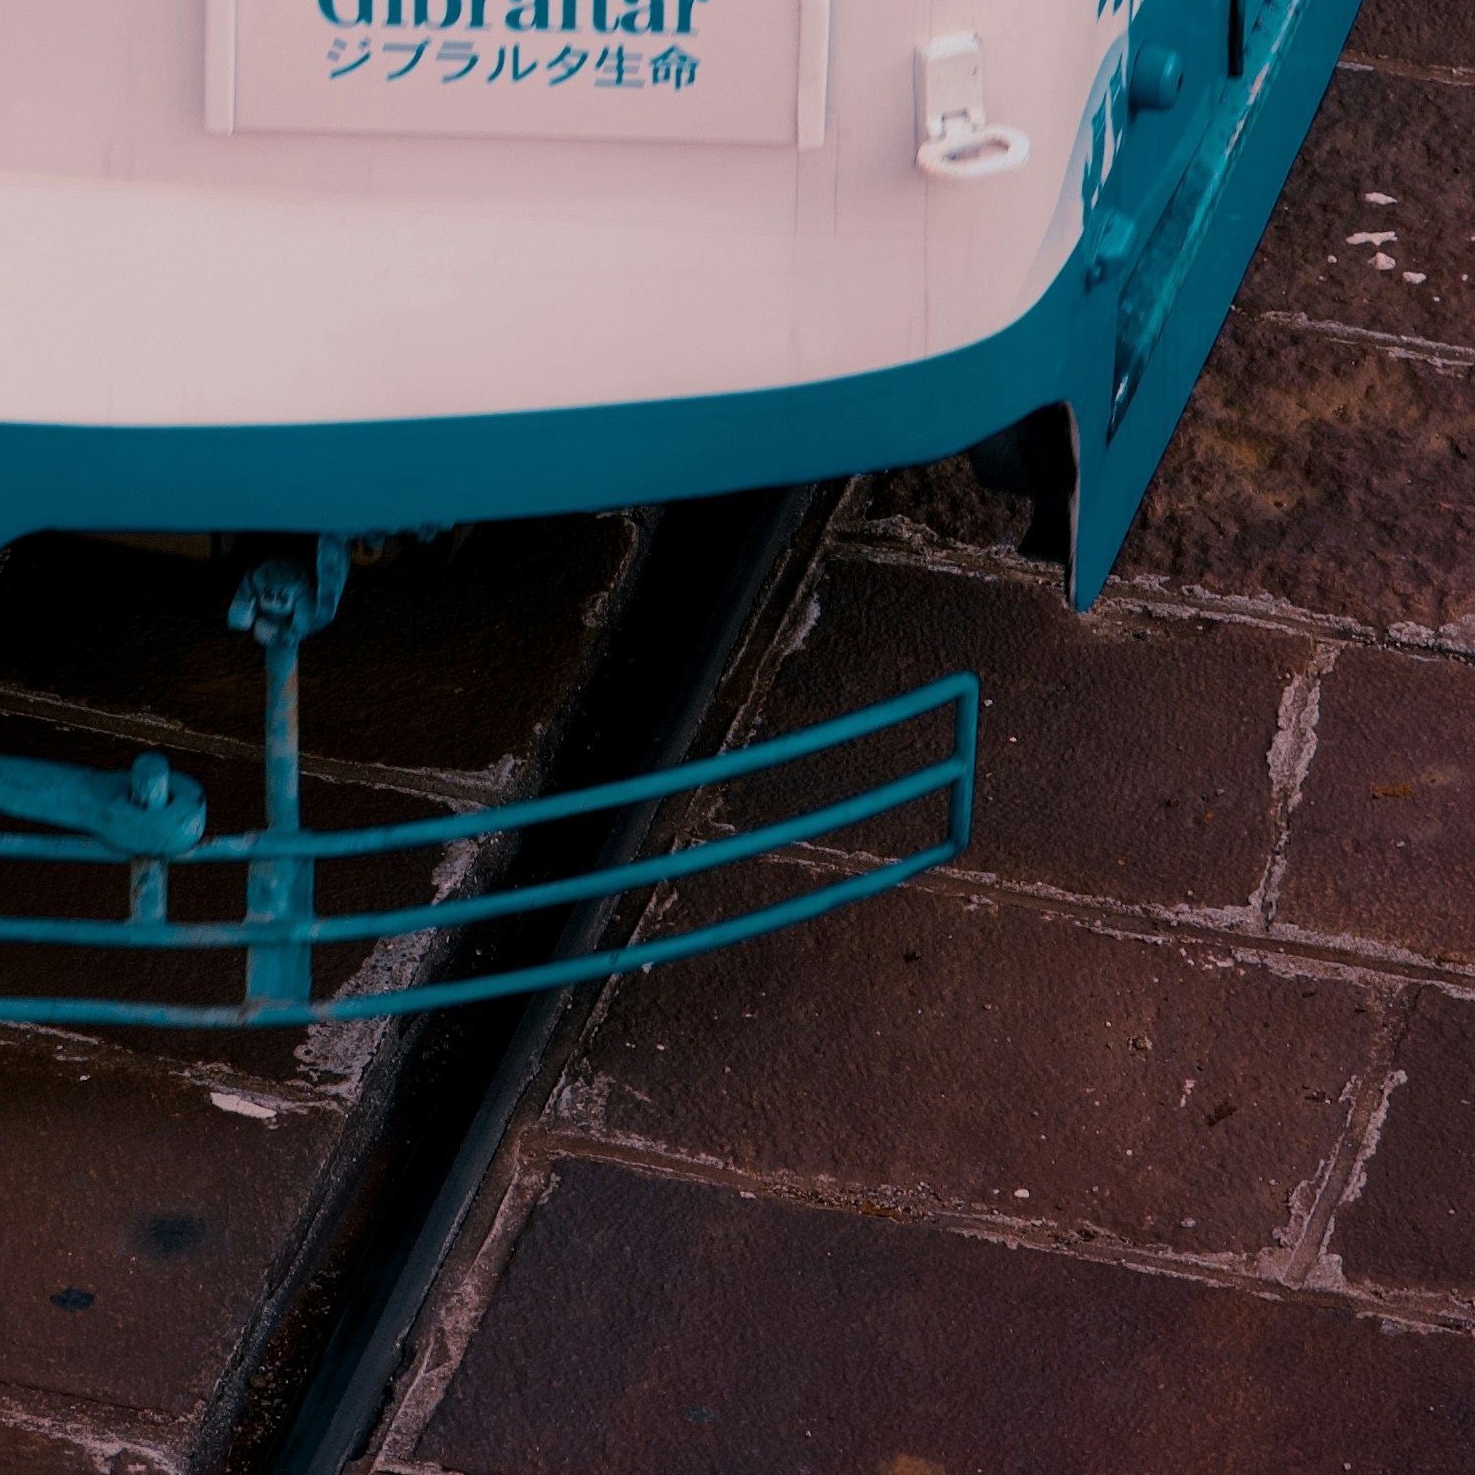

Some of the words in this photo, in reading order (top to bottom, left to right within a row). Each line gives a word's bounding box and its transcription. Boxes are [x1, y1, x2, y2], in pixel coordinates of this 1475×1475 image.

[327, 37, 701, 91] ジブラルタ生命
